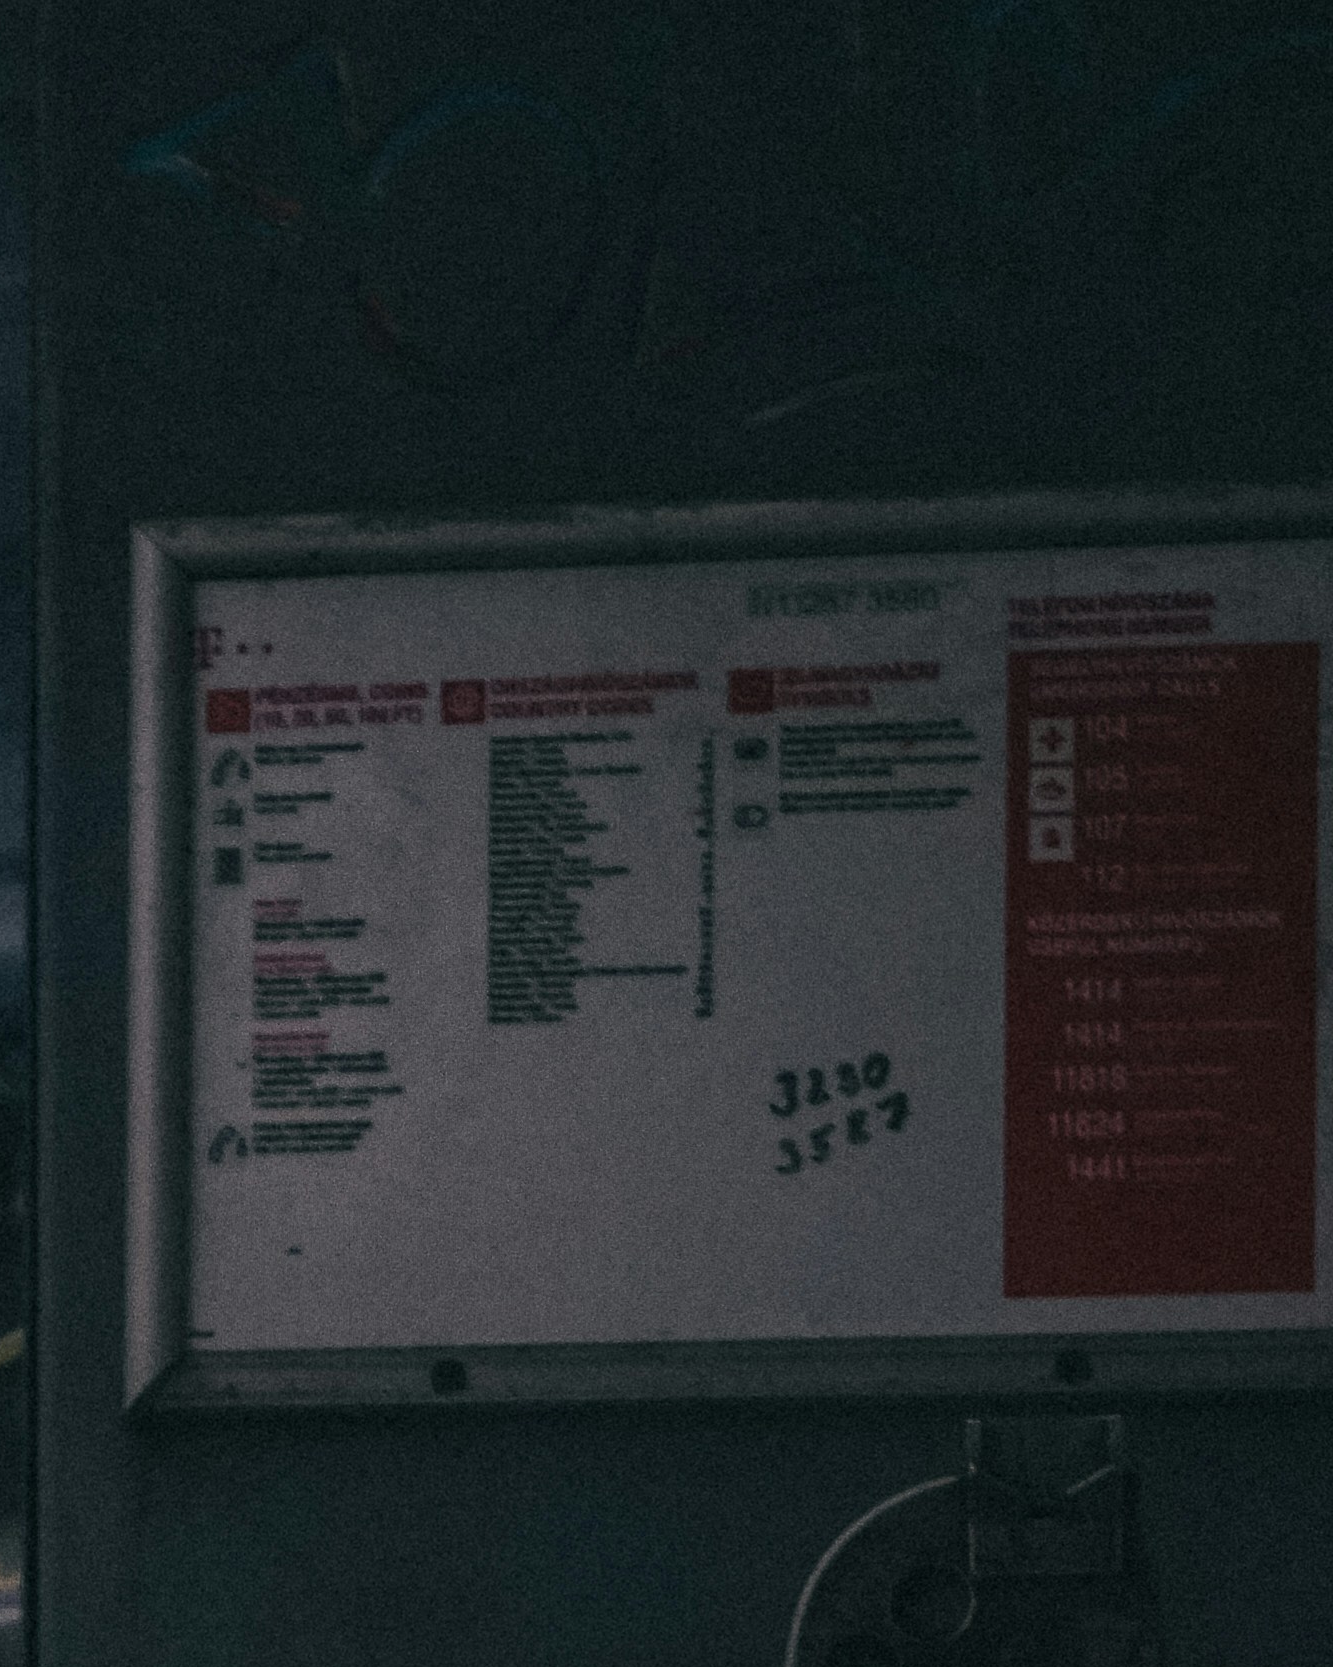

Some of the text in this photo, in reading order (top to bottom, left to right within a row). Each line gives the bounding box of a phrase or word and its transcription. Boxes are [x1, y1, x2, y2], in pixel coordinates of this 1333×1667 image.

[1083, 715, 1130, 743] 104
[1063, 976, 1124, 1003] 1414
[1066, 1153, 1127, 1181] 1441
